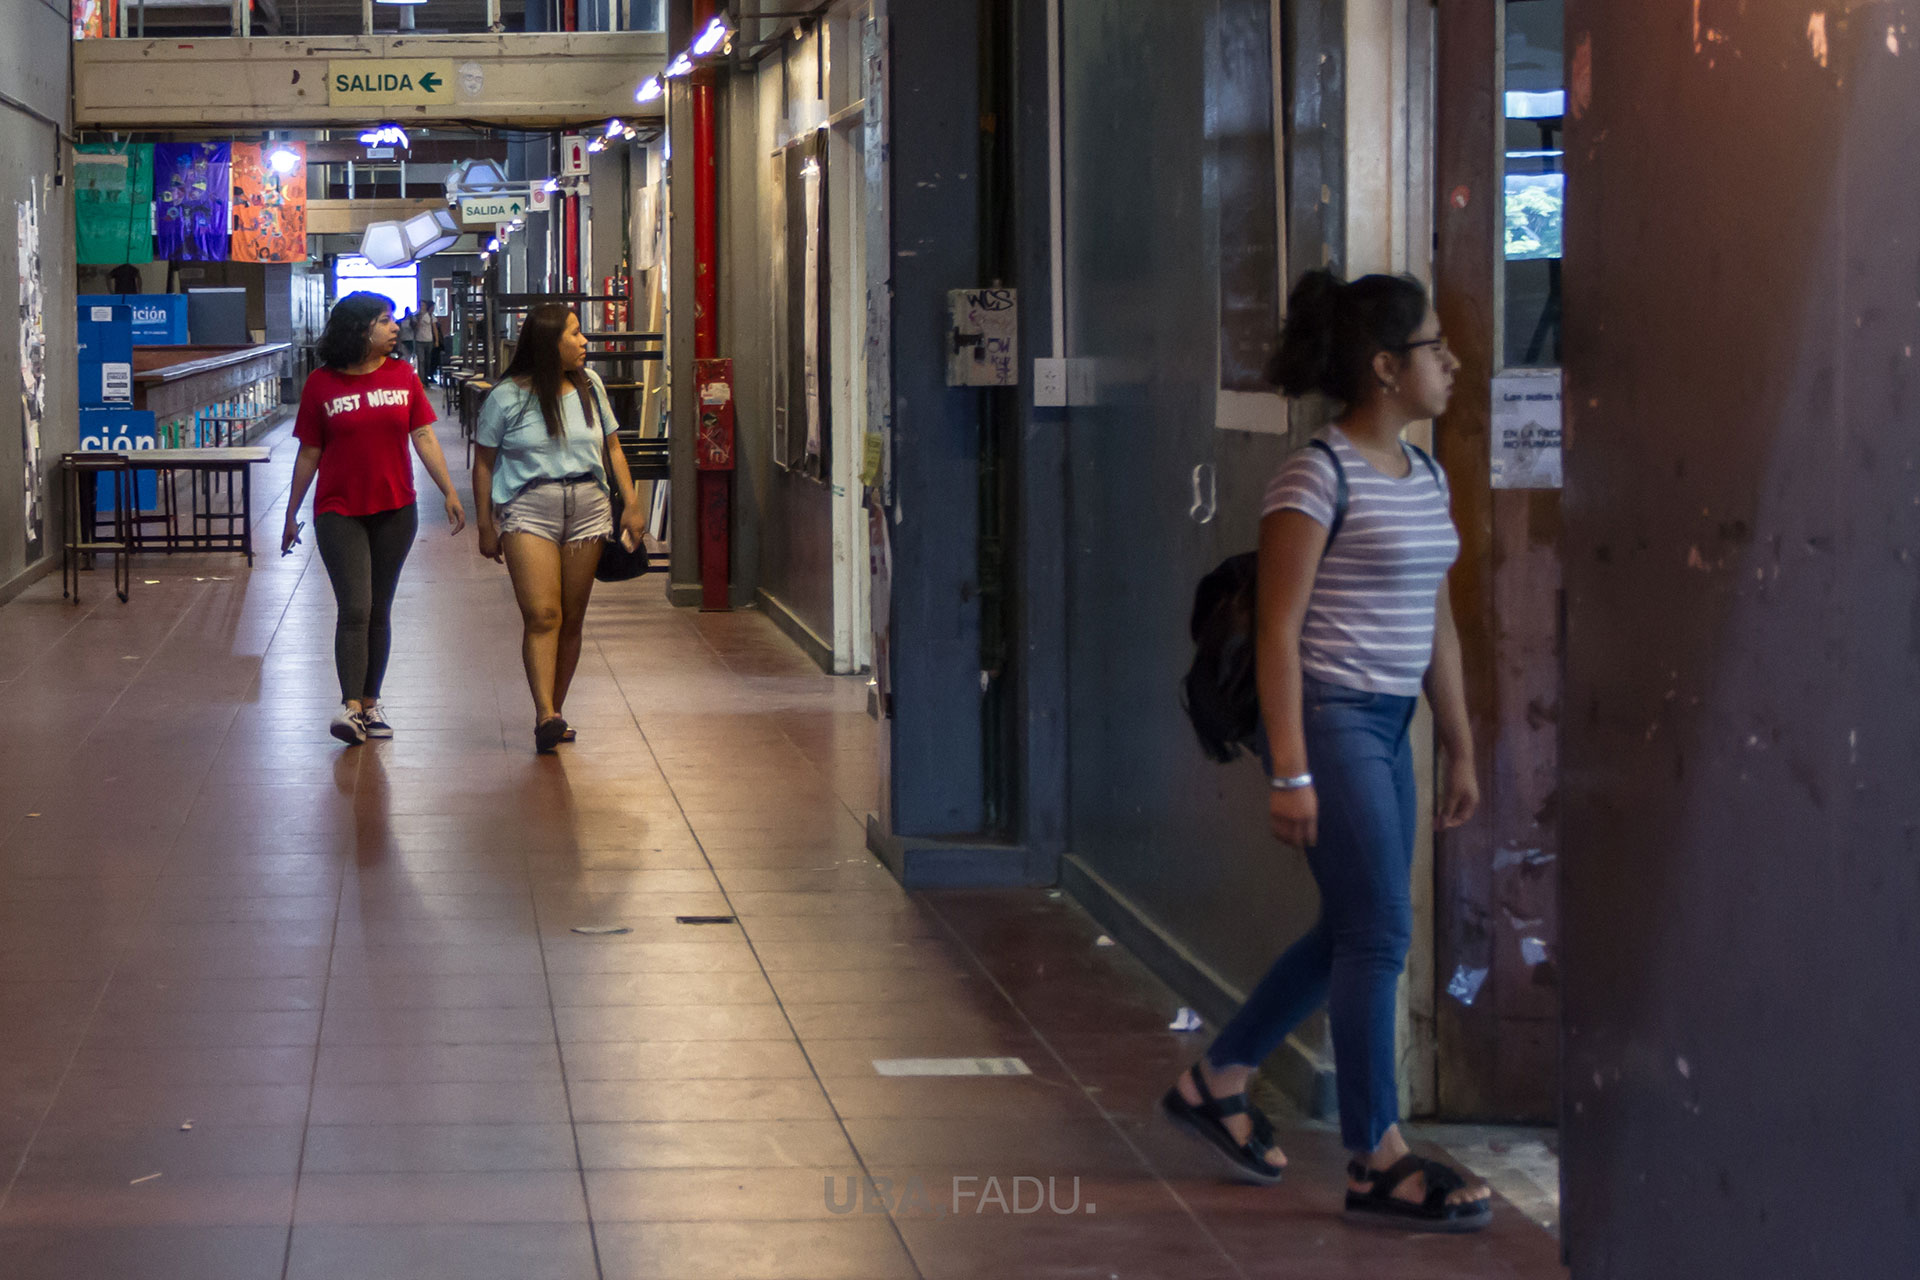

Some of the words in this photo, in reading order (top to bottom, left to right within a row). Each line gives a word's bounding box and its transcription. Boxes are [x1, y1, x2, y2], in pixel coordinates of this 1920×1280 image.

[336, 74, 413, 92] SALIDA
[466, 205, 505, 216] SALIDA
[324, 394, 361, 417] LAST
[366, 388, 410, 408] NIGHT
